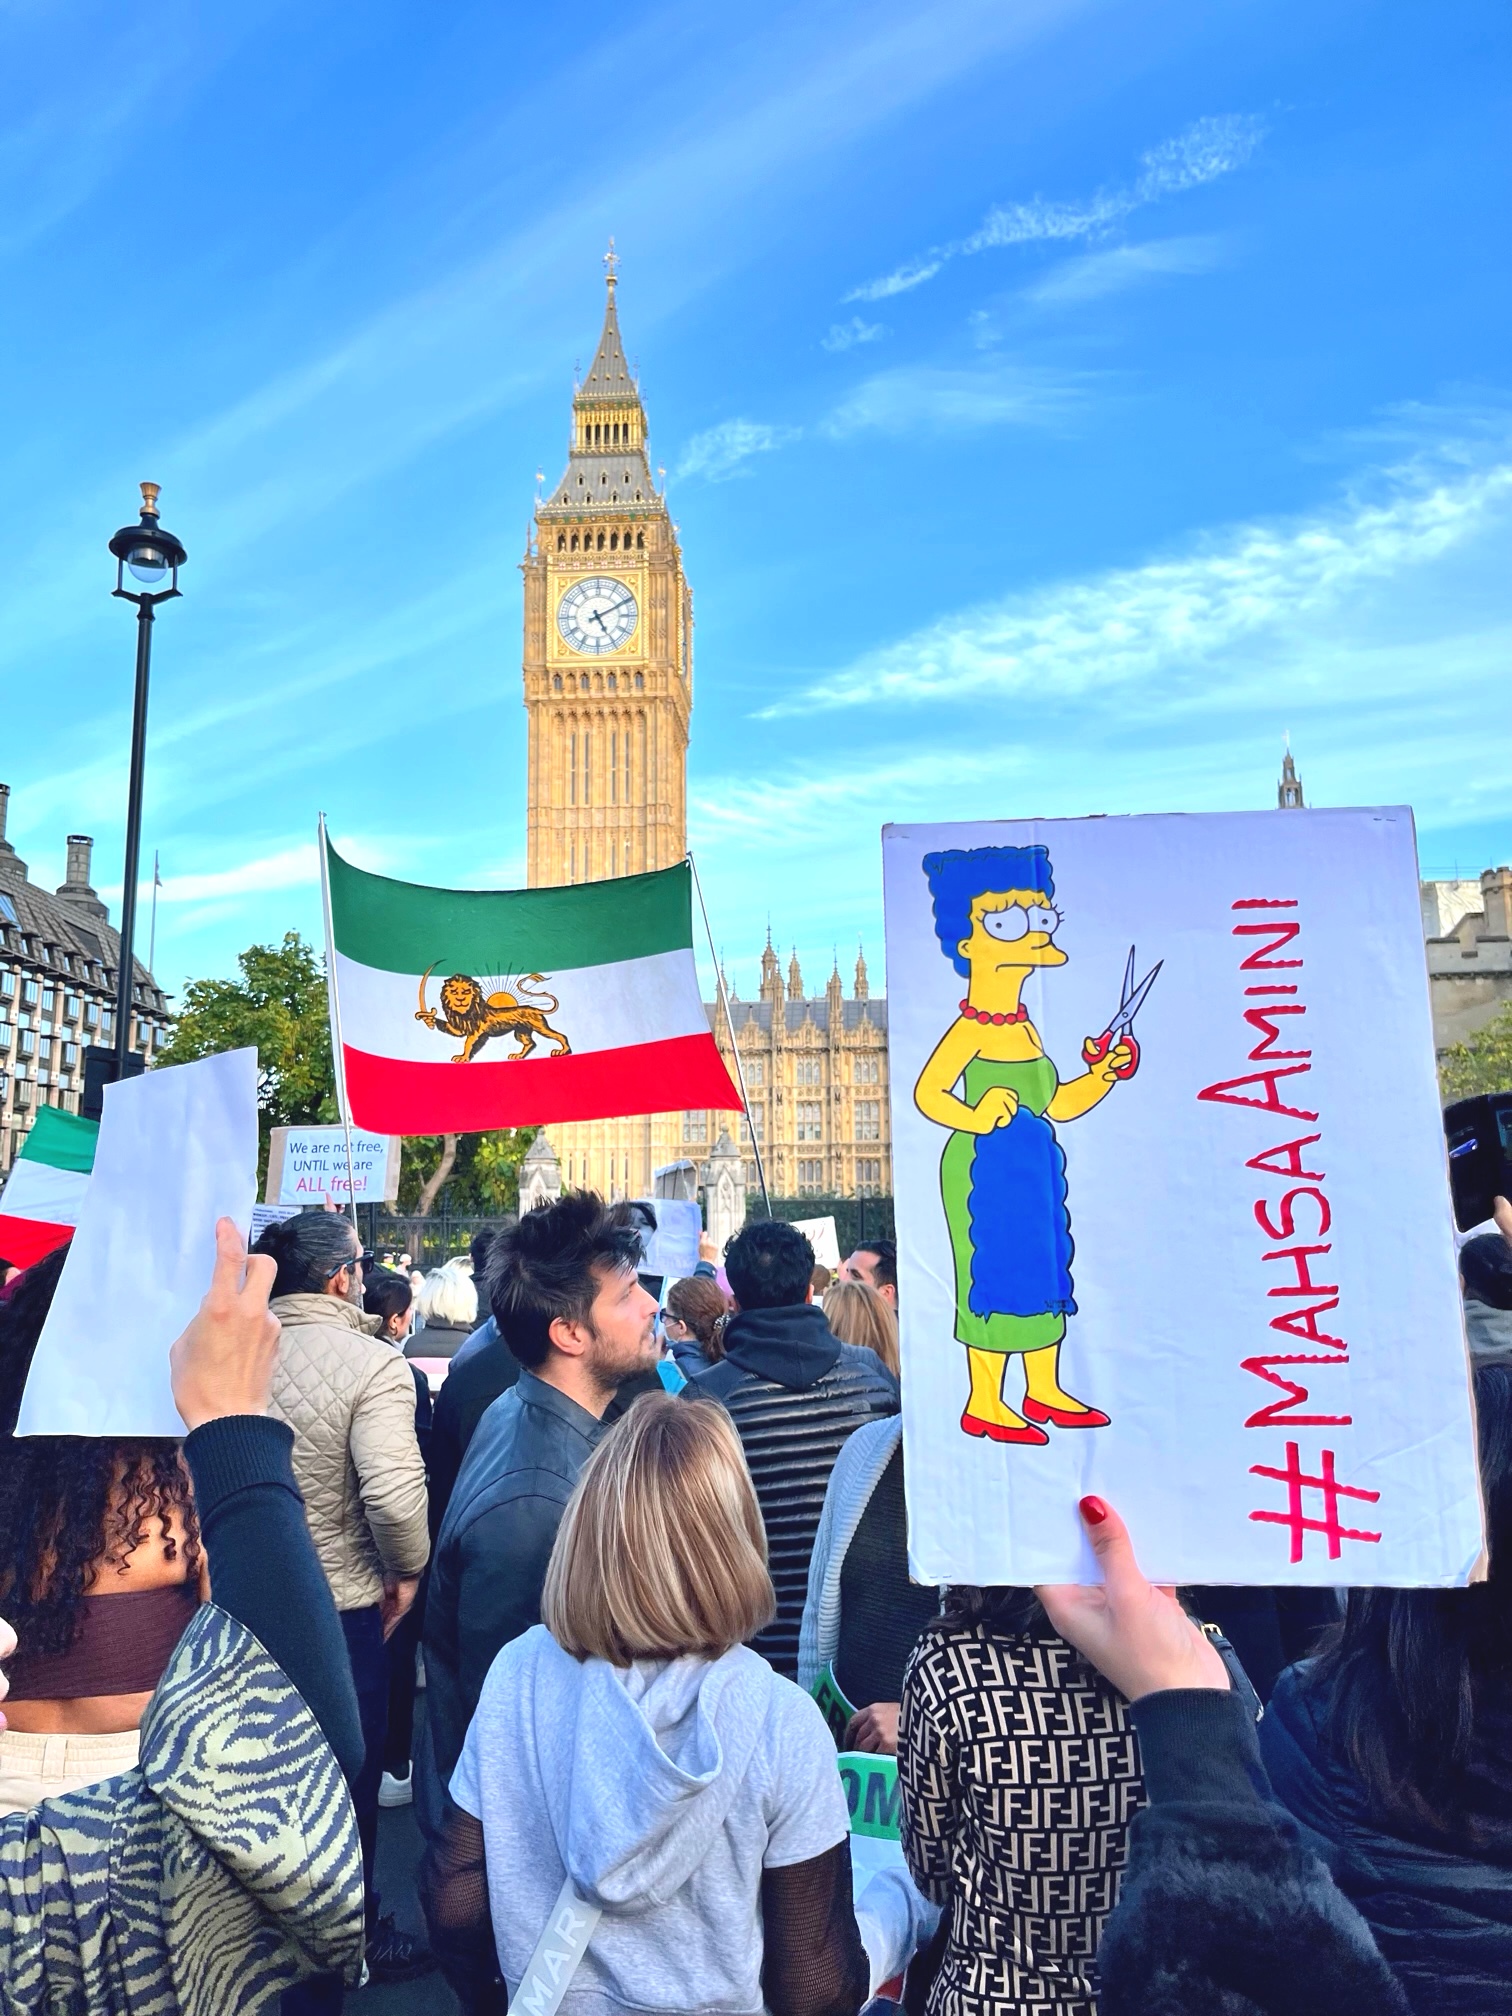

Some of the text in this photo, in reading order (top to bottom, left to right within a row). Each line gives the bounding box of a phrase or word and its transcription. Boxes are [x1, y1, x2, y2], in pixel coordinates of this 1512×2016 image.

[290, 1140, 384, 1153] We are not free,
[293, 1160, 372, 1171] UNTIL we are
[296, 1176, 367, 1192] ALL free!
[510, 1906, 588, 2016] MAR
